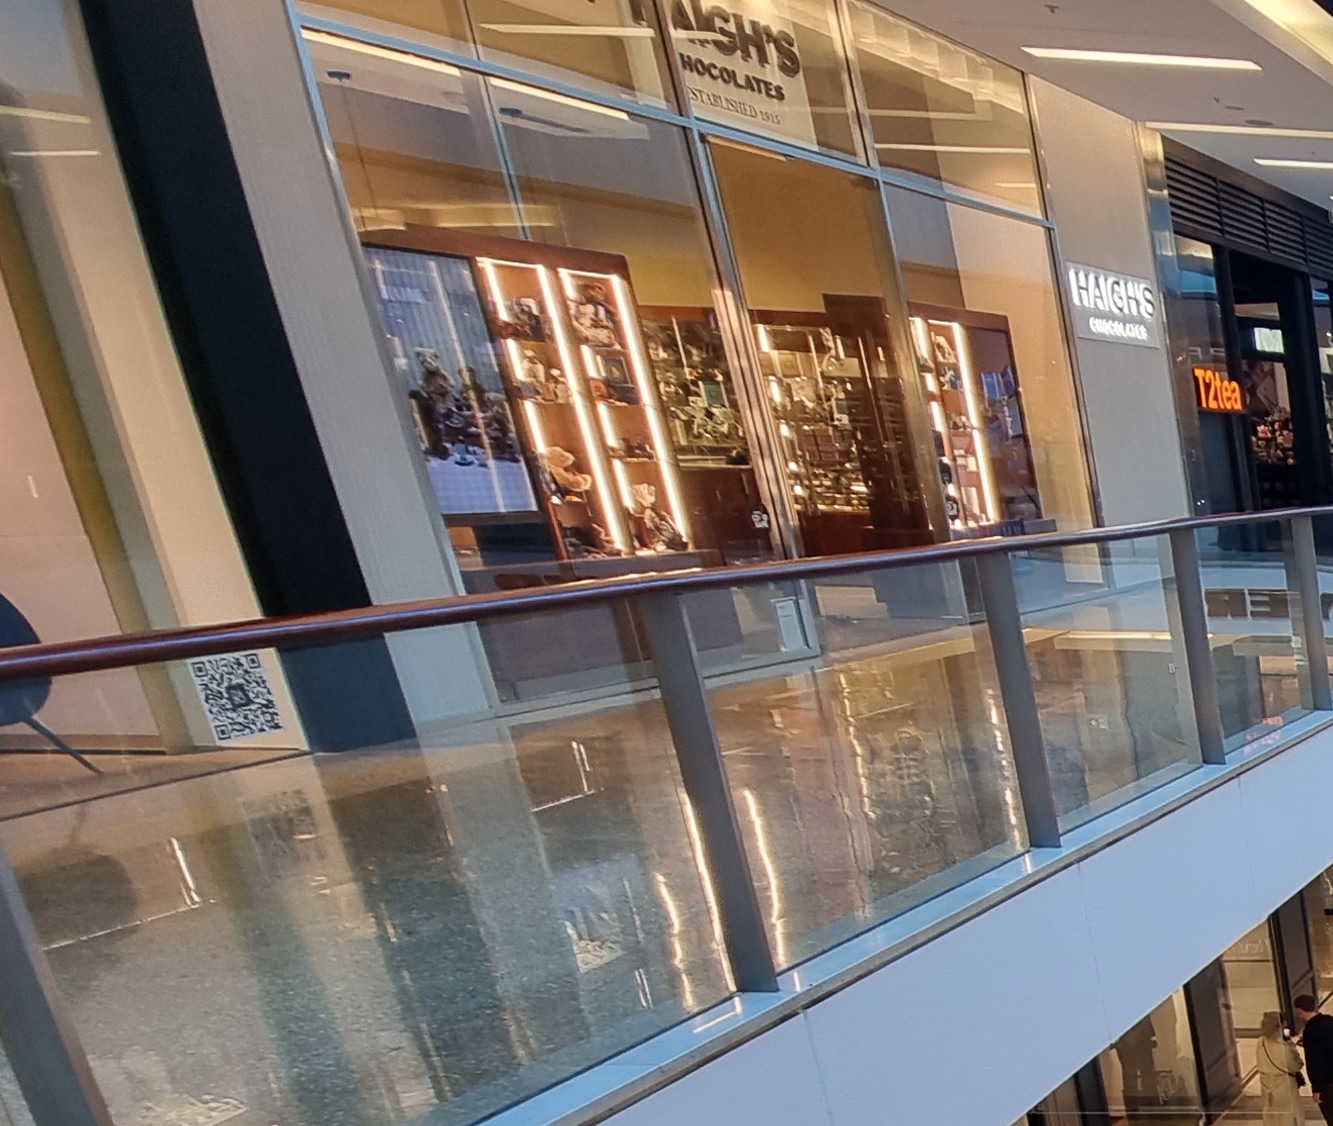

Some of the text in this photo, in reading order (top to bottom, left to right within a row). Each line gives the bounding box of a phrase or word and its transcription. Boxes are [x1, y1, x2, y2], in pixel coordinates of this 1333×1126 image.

[679, 53, 785, 101] HOCOLATES
[1069, 268, 1155, 319] HAIGH'S
[1194, 367, 1243, 410] T2tea
